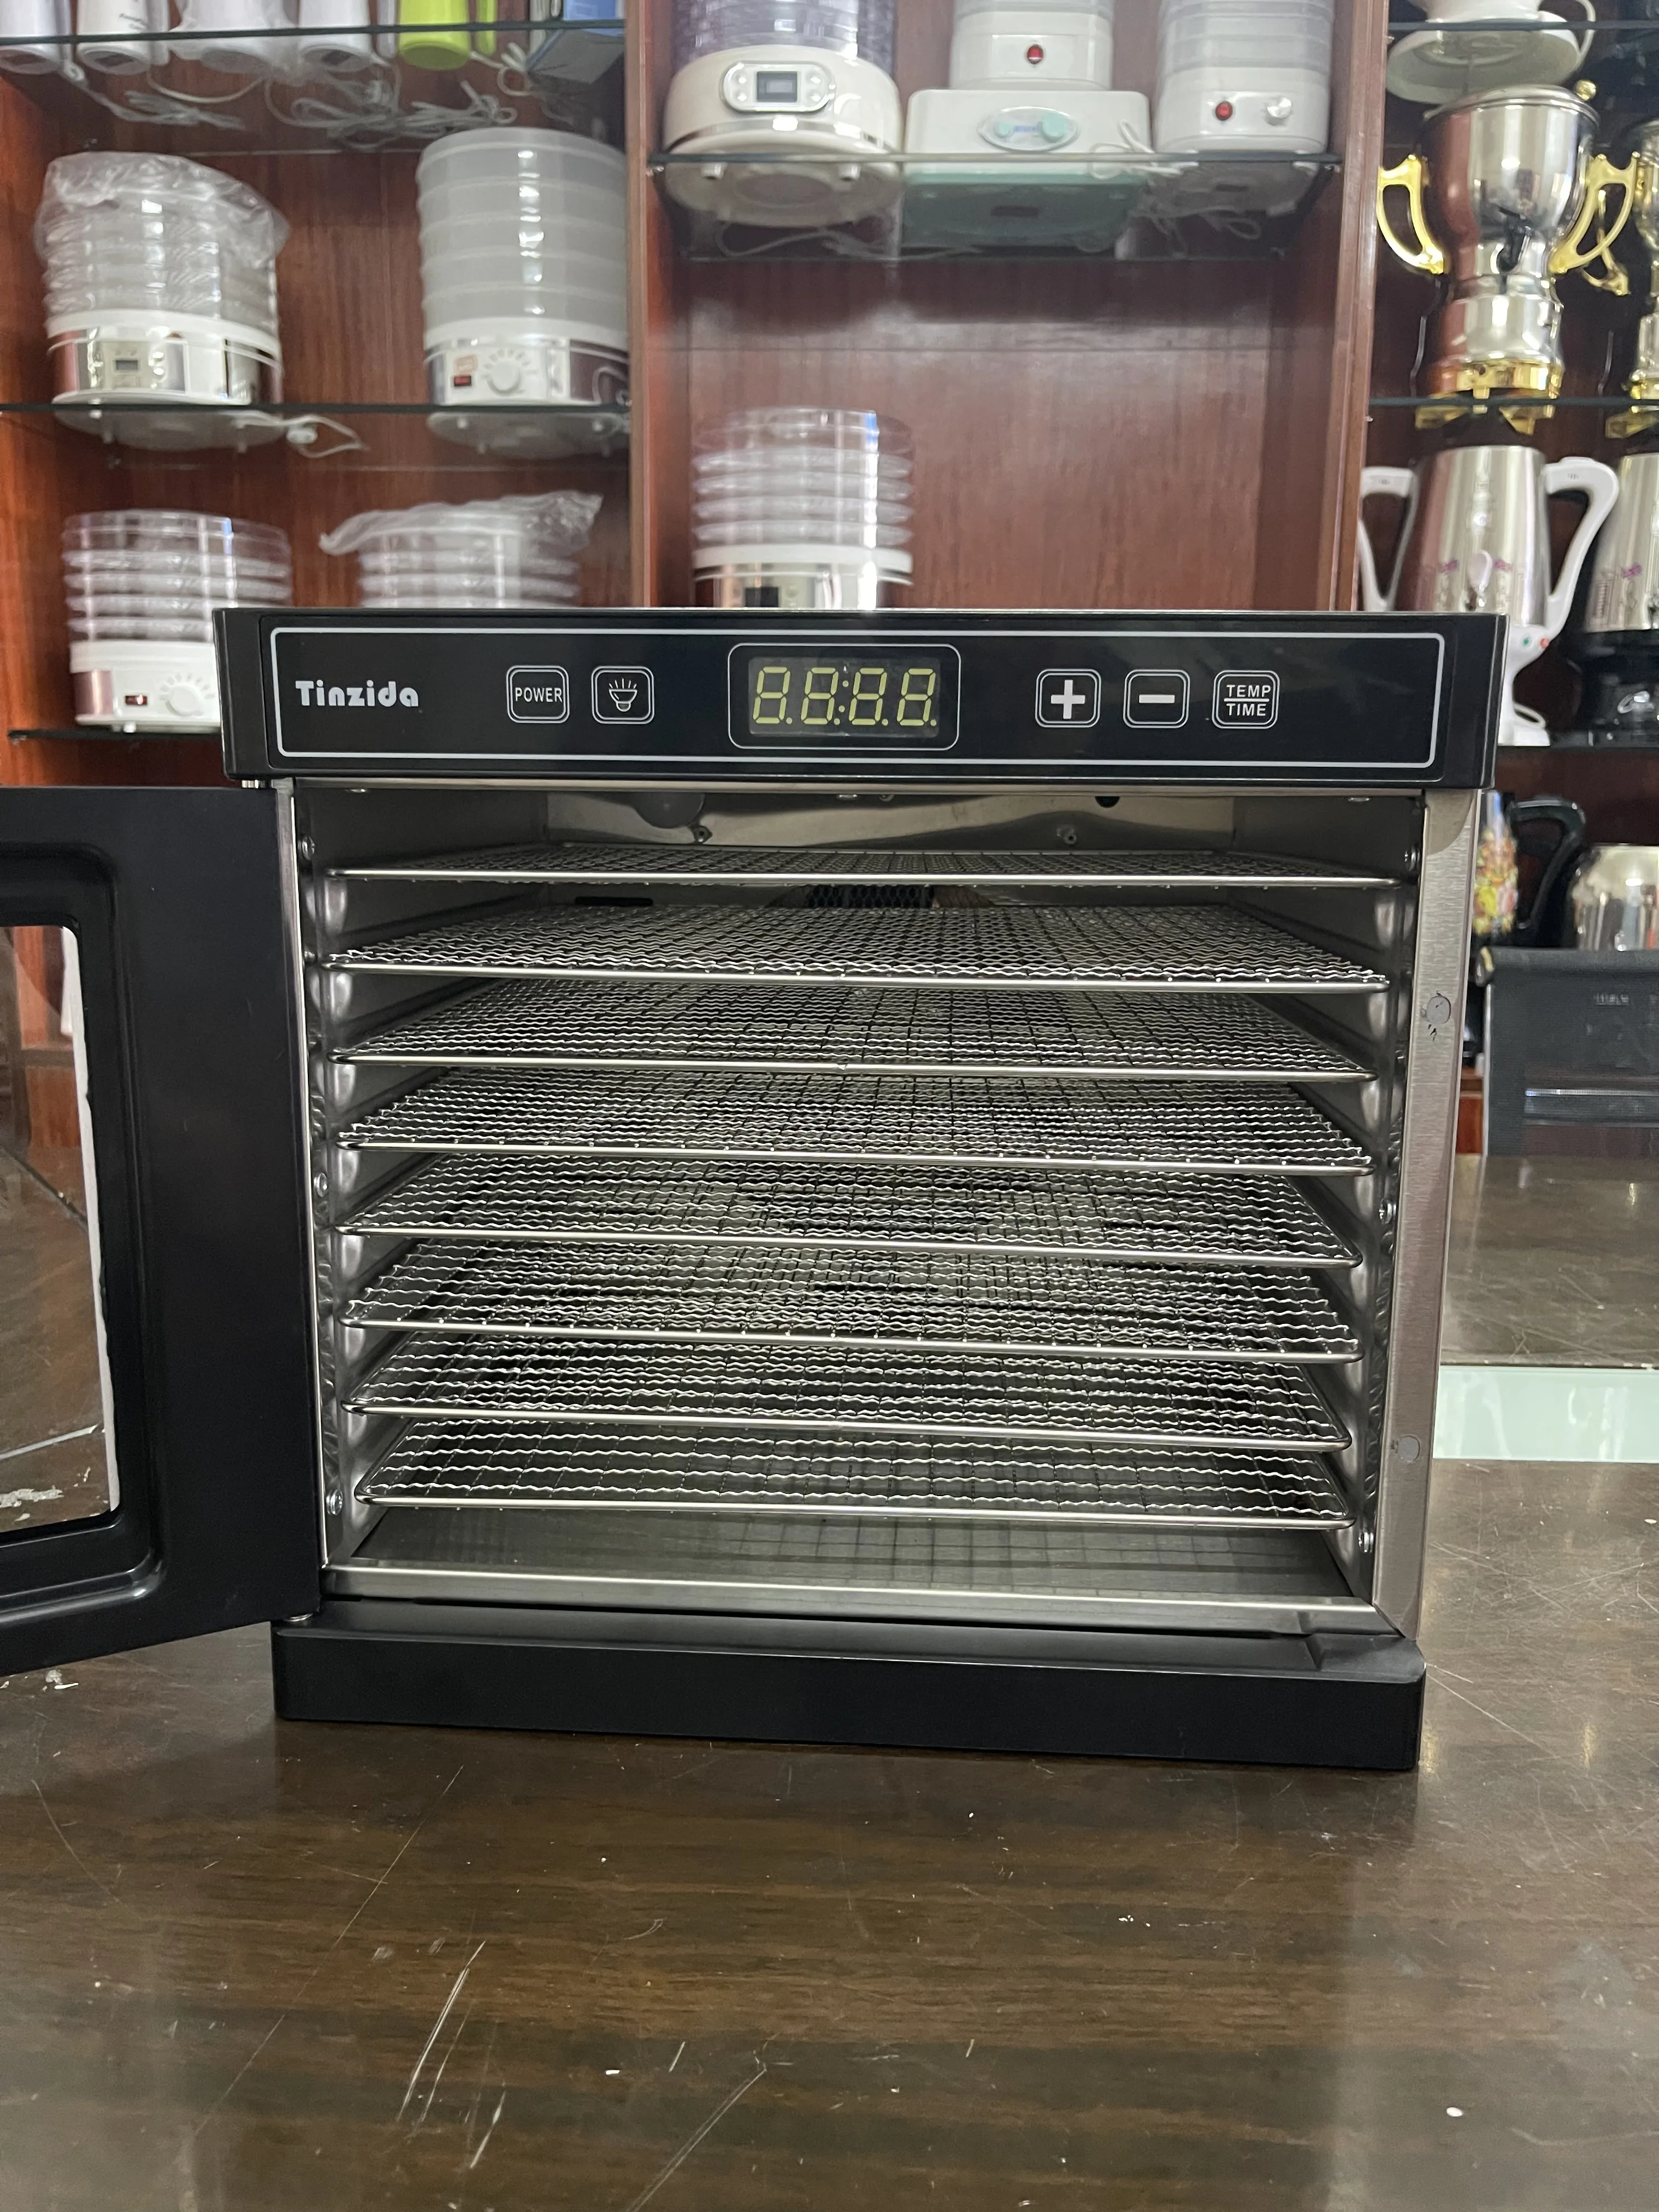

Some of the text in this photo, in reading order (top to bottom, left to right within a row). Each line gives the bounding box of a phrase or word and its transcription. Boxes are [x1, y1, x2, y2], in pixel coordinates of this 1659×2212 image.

[295, 679, 419, 708] Tinzida
[514, 686, 563, 703] POWER
[1226, 684, 1272, 698] TEMP
[1226, 703, 1267, 716] TIME
